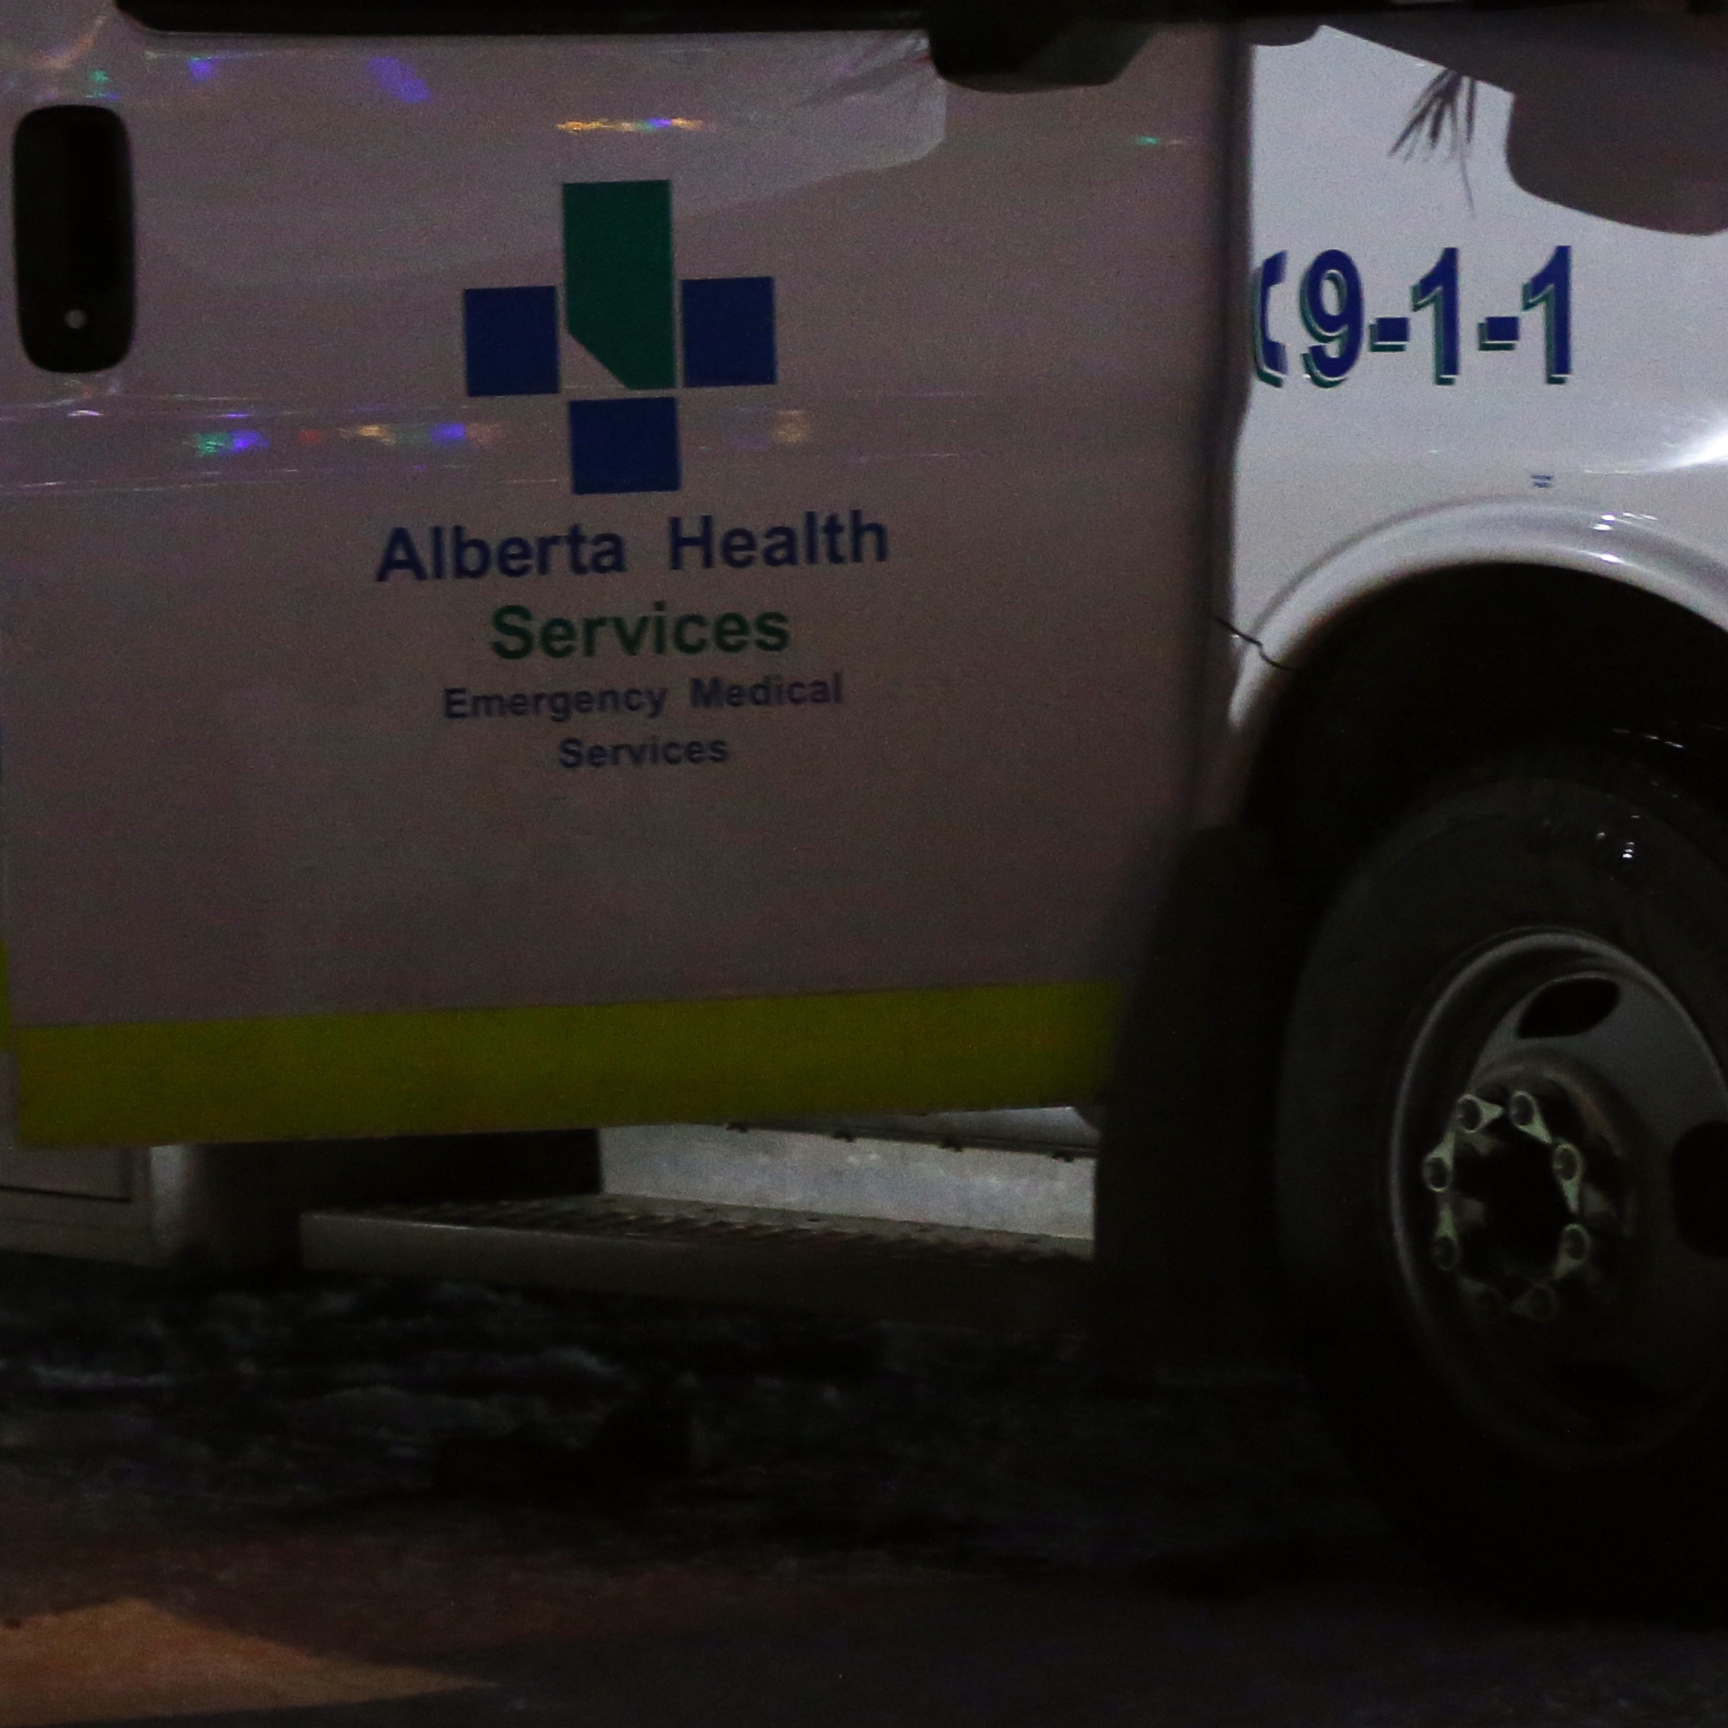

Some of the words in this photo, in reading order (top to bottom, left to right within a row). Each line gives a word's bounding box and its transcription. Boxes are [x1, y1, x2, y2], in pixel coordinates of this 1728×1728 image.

[1299, 245, 1573, 387] 9-1-1
[376, 524, 627, 582] Alberta
[669, 509, 890, 571] Health
[491, 601, 791, 660] Services
[443, 685, 668, 724] Emergency
[689, 672, 844, 709] Medical
[559, 737, 729, 770] Services
